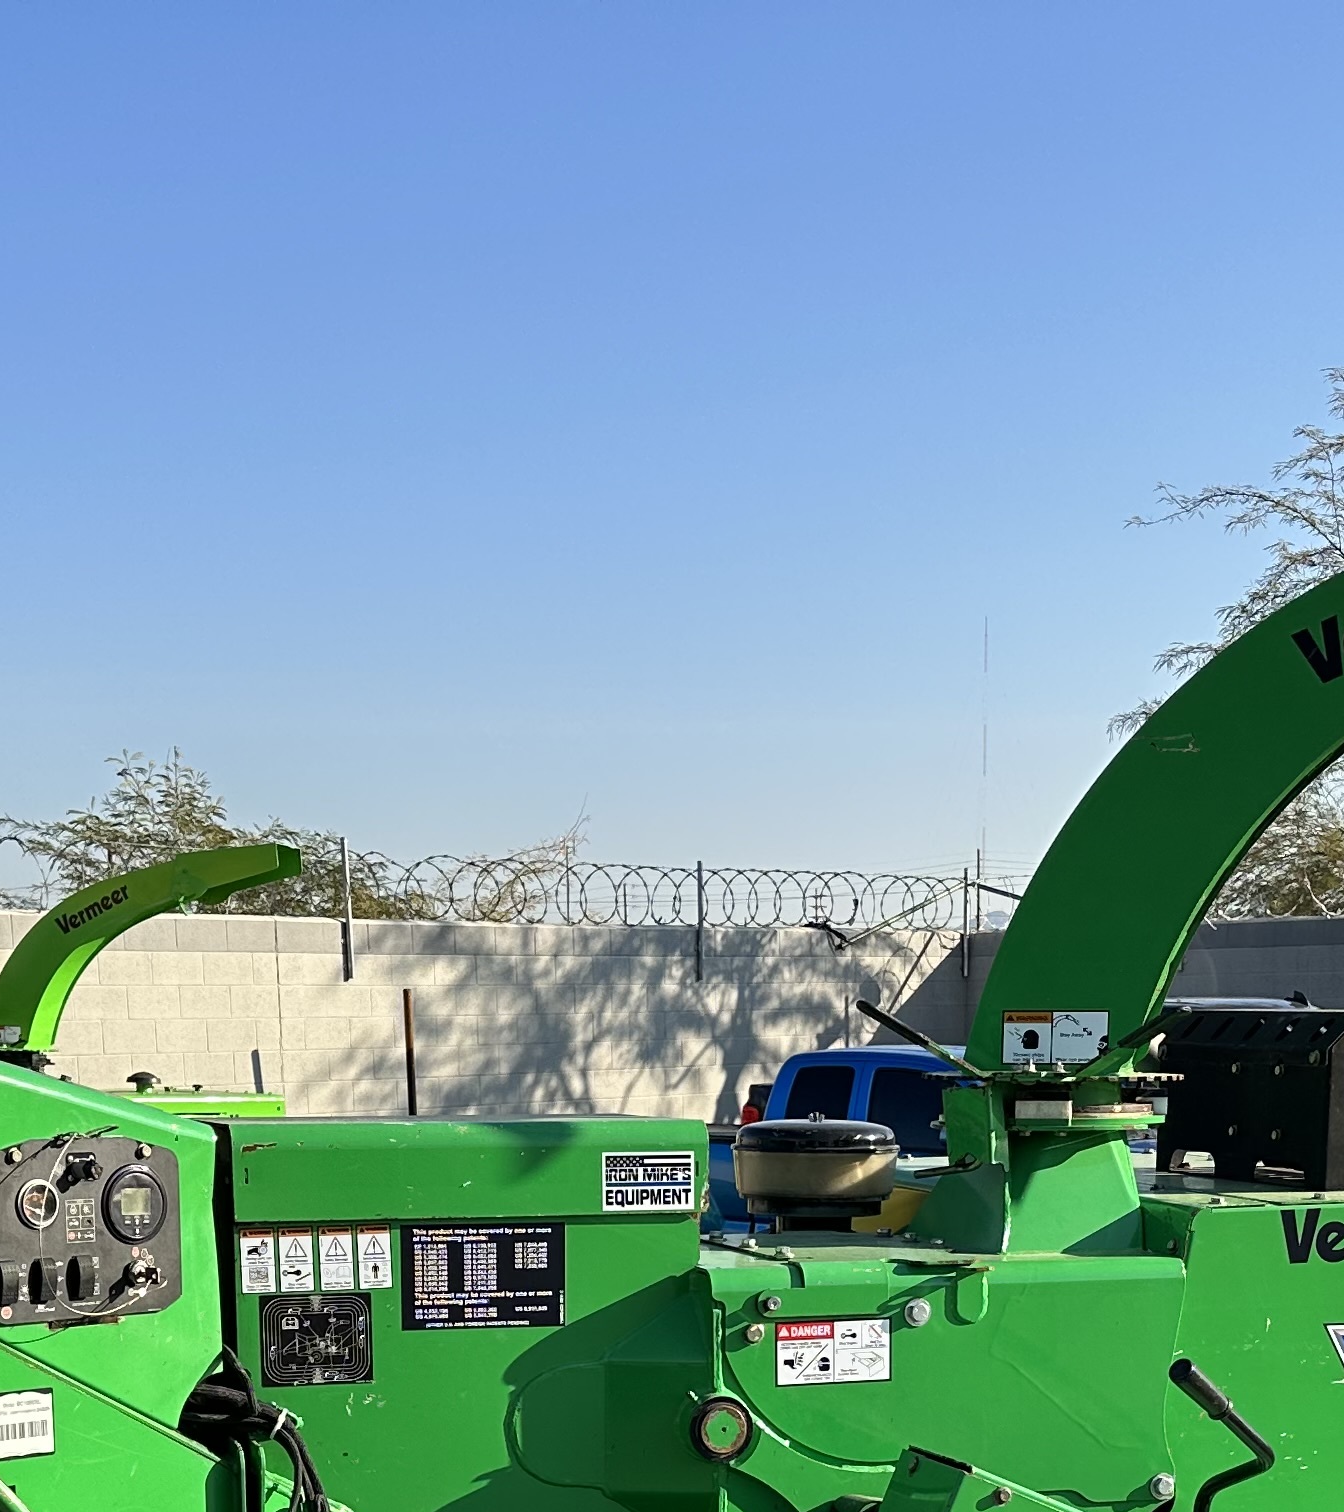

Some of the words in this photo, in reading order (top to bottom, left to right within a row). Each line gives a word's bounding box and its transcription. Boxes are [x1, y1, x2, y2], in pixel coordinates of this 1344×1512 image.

[54, 884, 129, 935] Vermeer
[605, 1167, 639, 1182] IRON
[605, 1188, 692, 1207] EQUIPMENT
[790, 1325, 831, 1337] DANGER
